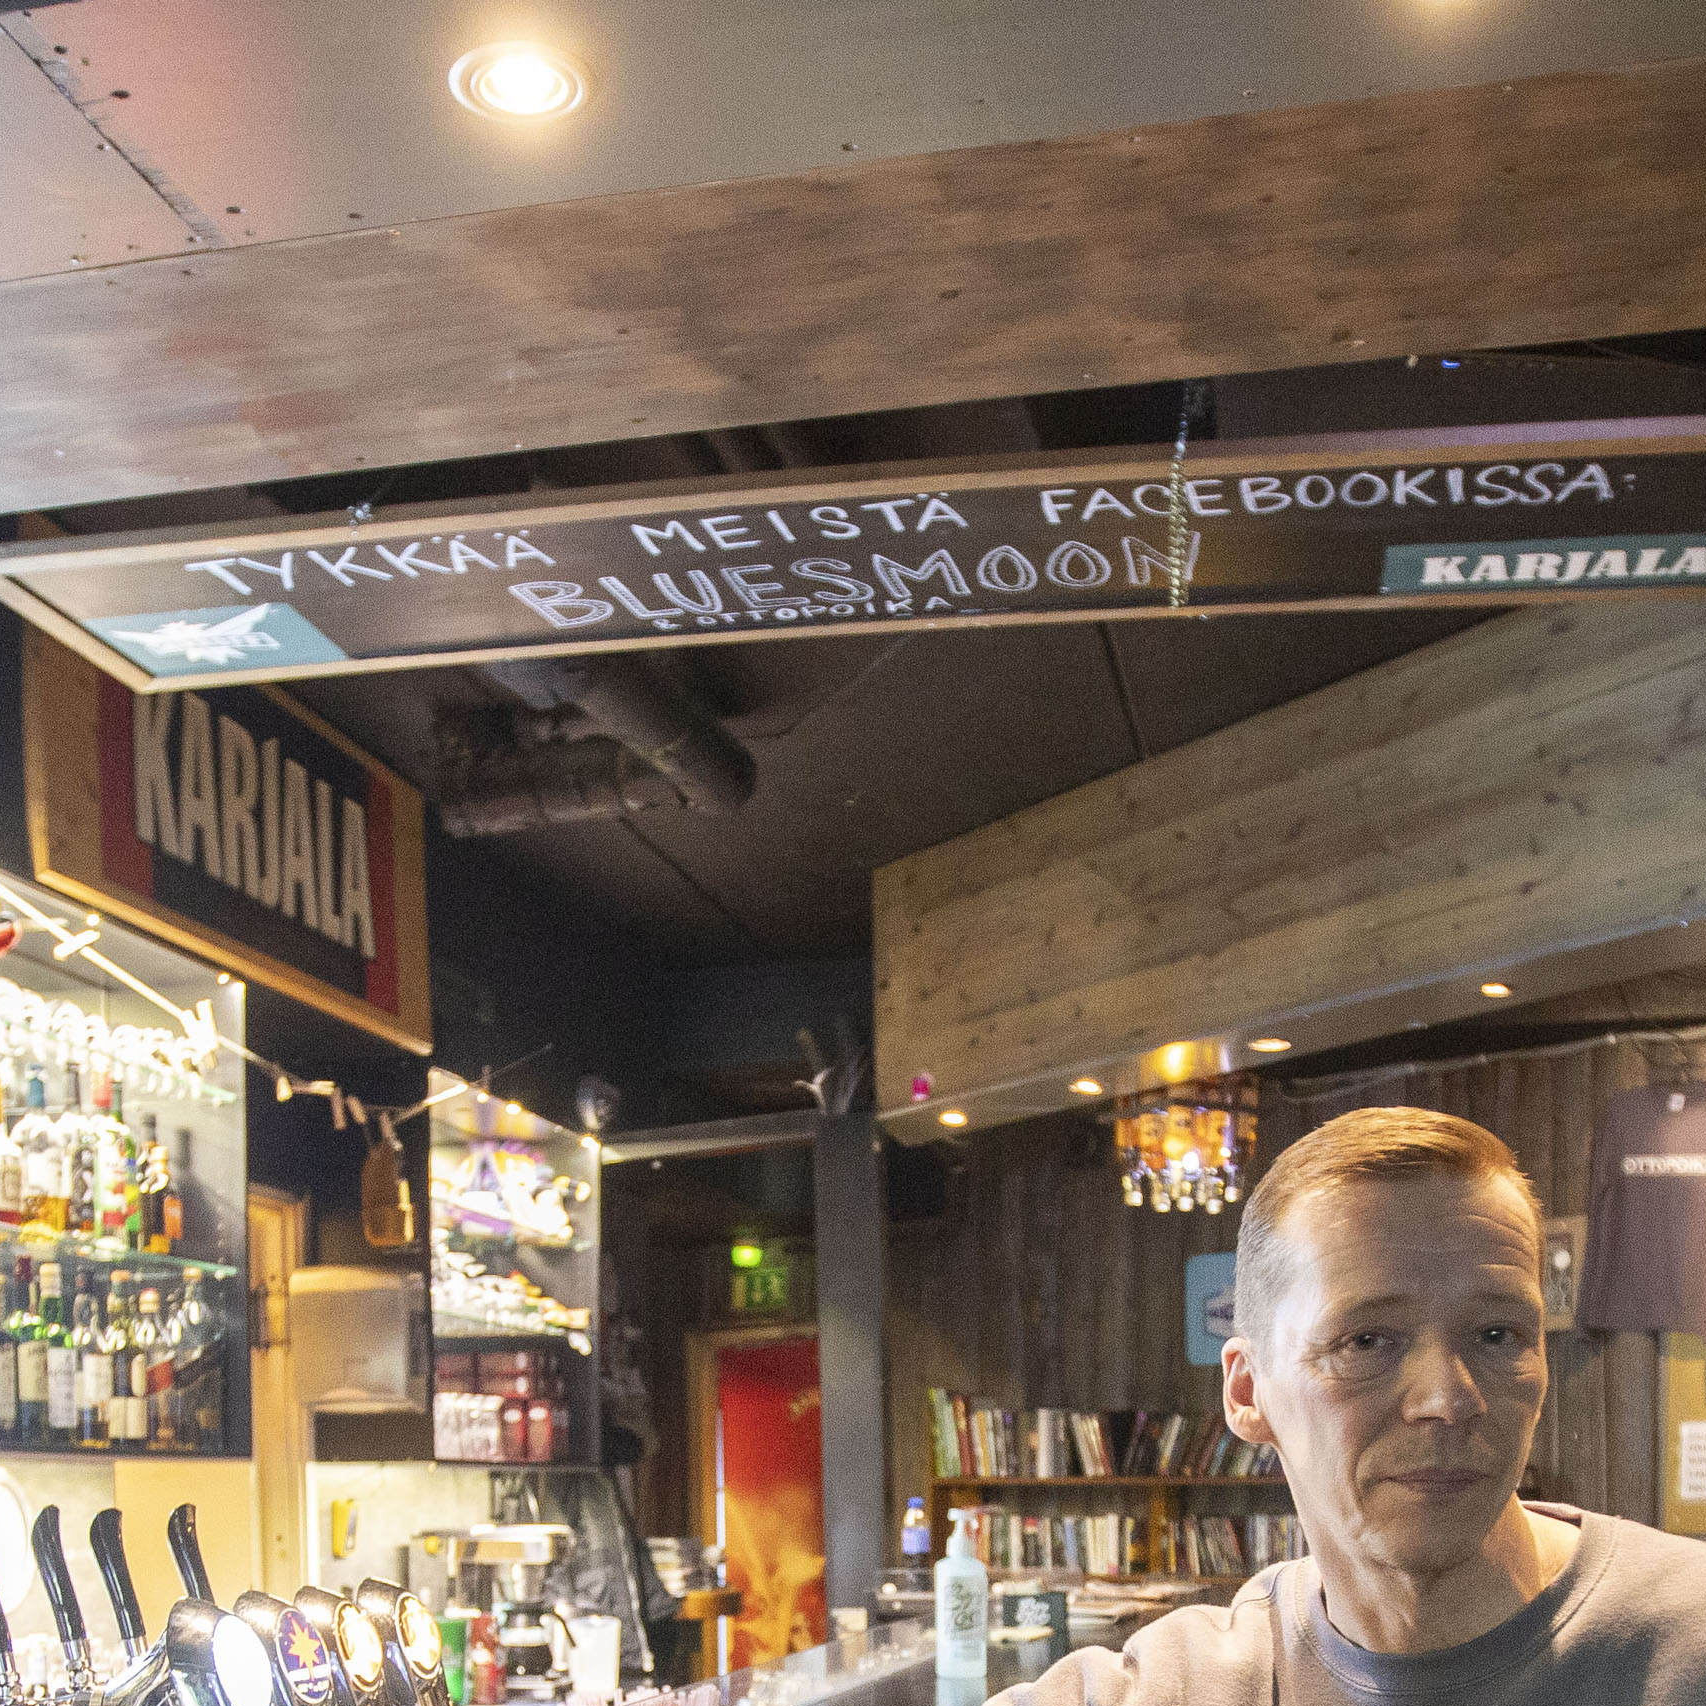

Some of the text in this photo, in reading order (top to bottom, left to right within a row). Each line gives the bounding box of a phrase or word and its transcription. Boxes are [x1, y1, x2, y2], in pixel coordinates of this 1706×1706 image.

[184, 530, 557, 595] TYKKÄÄ
[630, 492, 968, 558] MEISTÄ
[508, 531, 1201, 629] BLUESMOON
[696, 597, 953, 627] OTTOPOIKA
[133, 690, 376, 960] KARJALA
